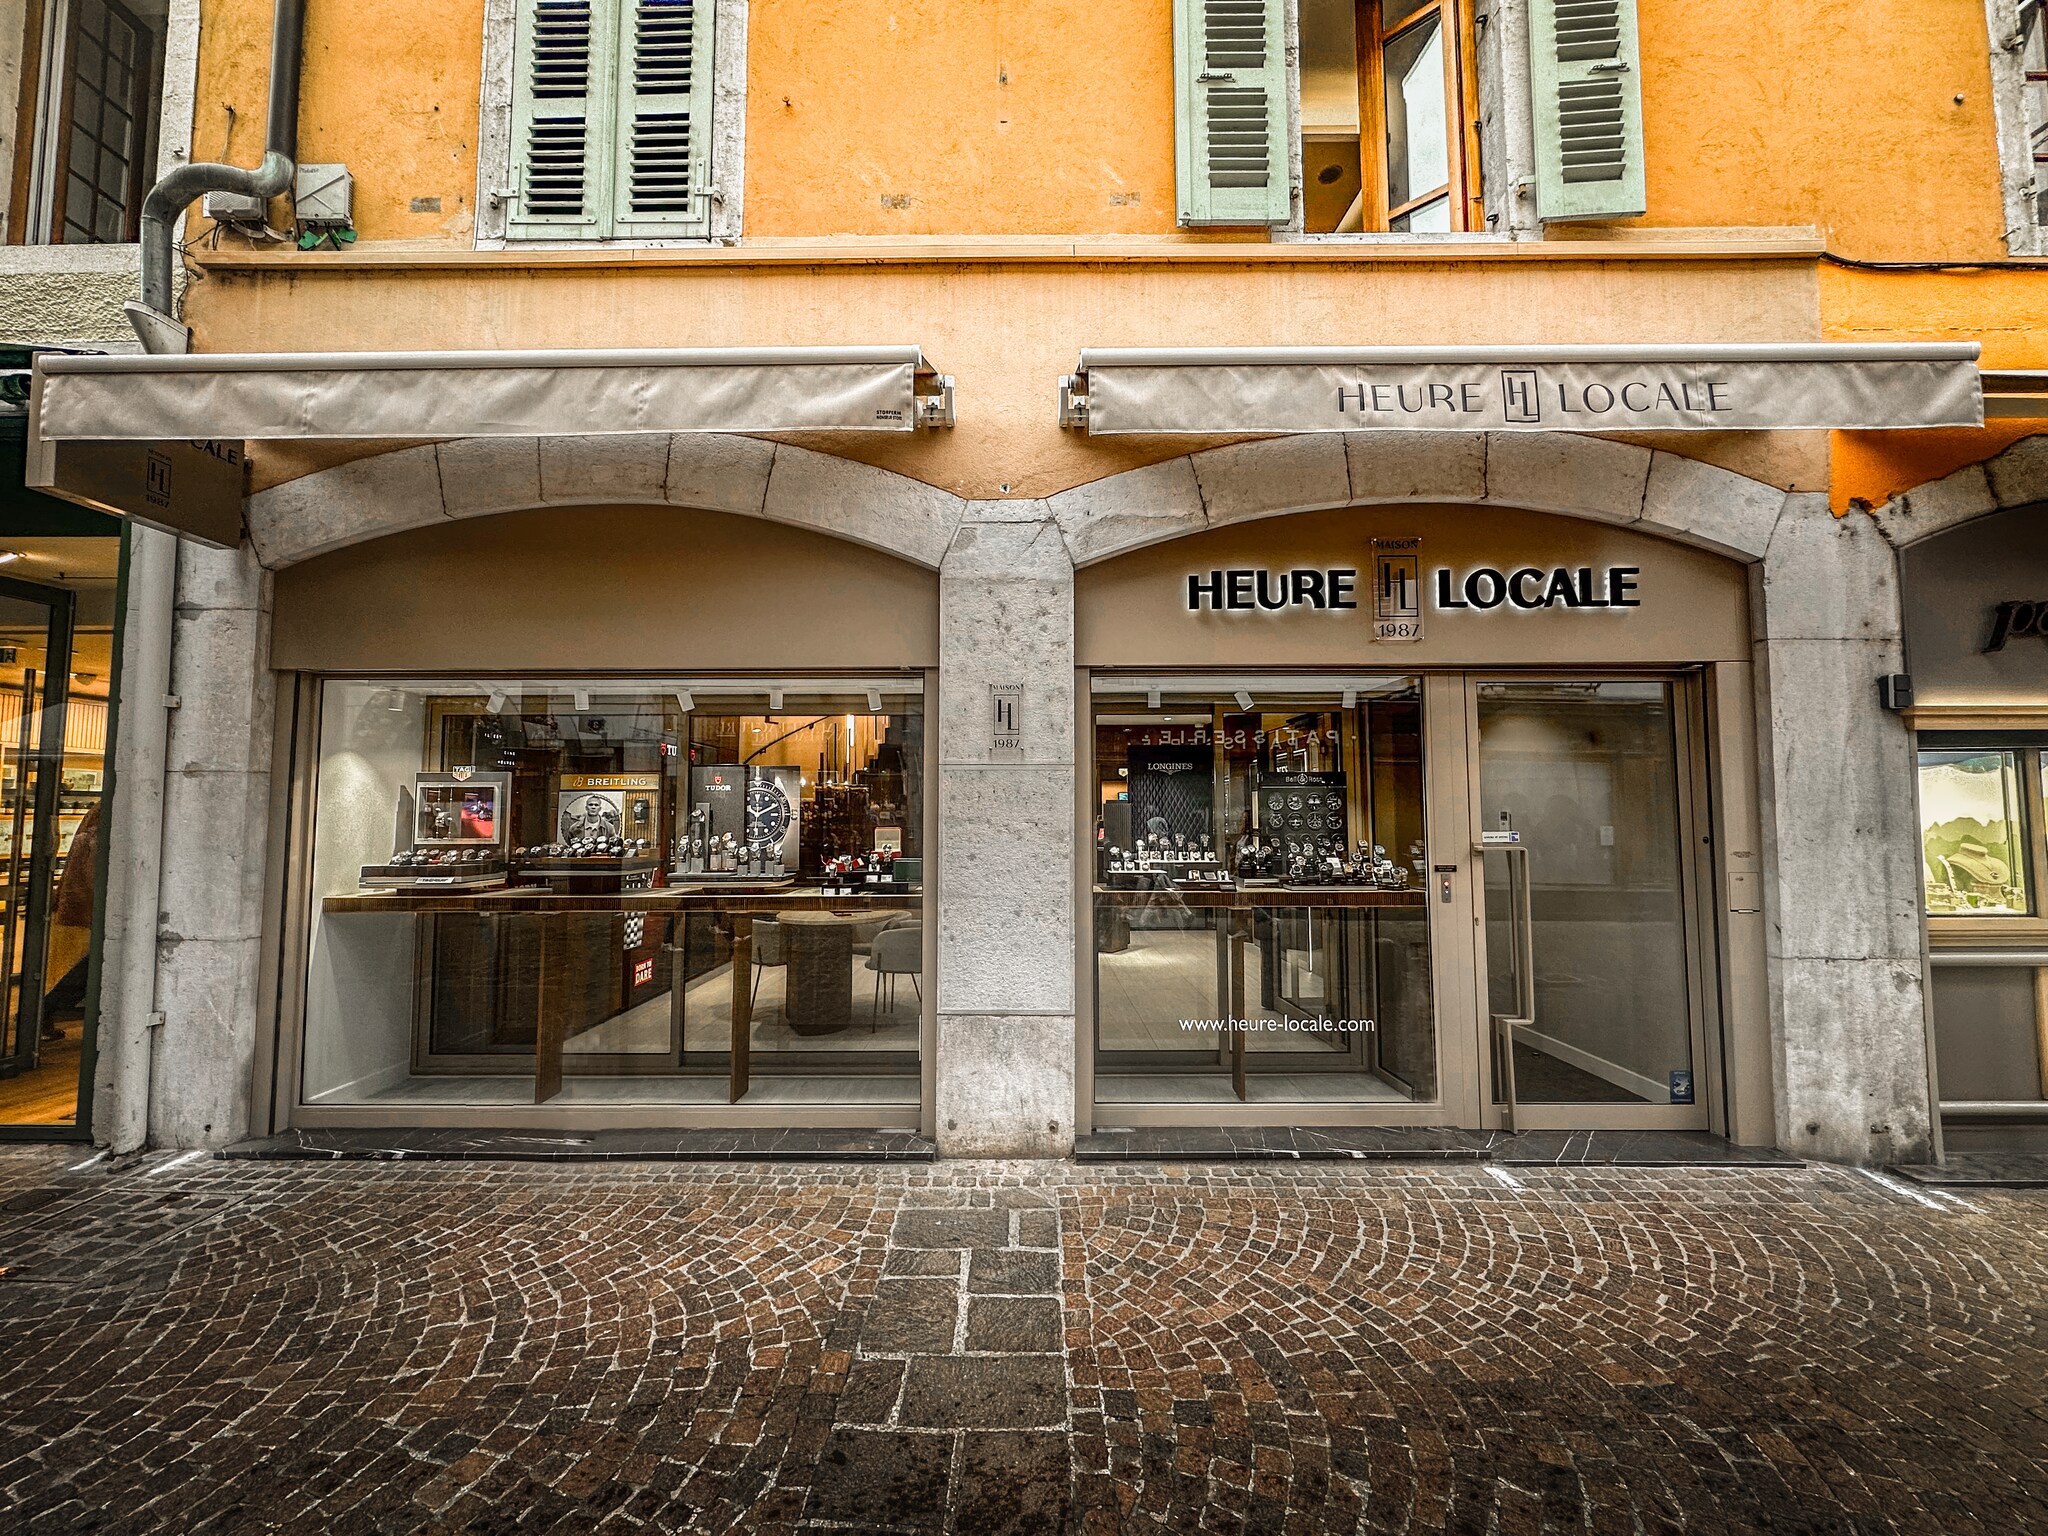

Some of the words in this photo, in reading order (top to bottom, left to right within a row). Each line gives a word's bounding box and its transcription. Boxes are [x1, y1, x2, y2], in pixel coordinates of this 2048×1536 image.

[1337, 382, 1484, 413] HEURE
[1557, 381, 1734, 413] LOCALE
[188, 439, 238, 465] CALE
[1375, 539, 1419, 549] MAISON
[1187, 568, 1358, 611] HEURE
[1436, 566, 1641, 609] LOCALE
[1378, 622, 1421, 638] 1987
[993, 739, 1020, 748] 1987
[1147, 762, 1194, 771] LONGINES
[587, 777, 647, 786] BREITLING
[635, 967, 653, 985] DARE
[1178, 1014, 1375, 1032] www.heure-locale.com
